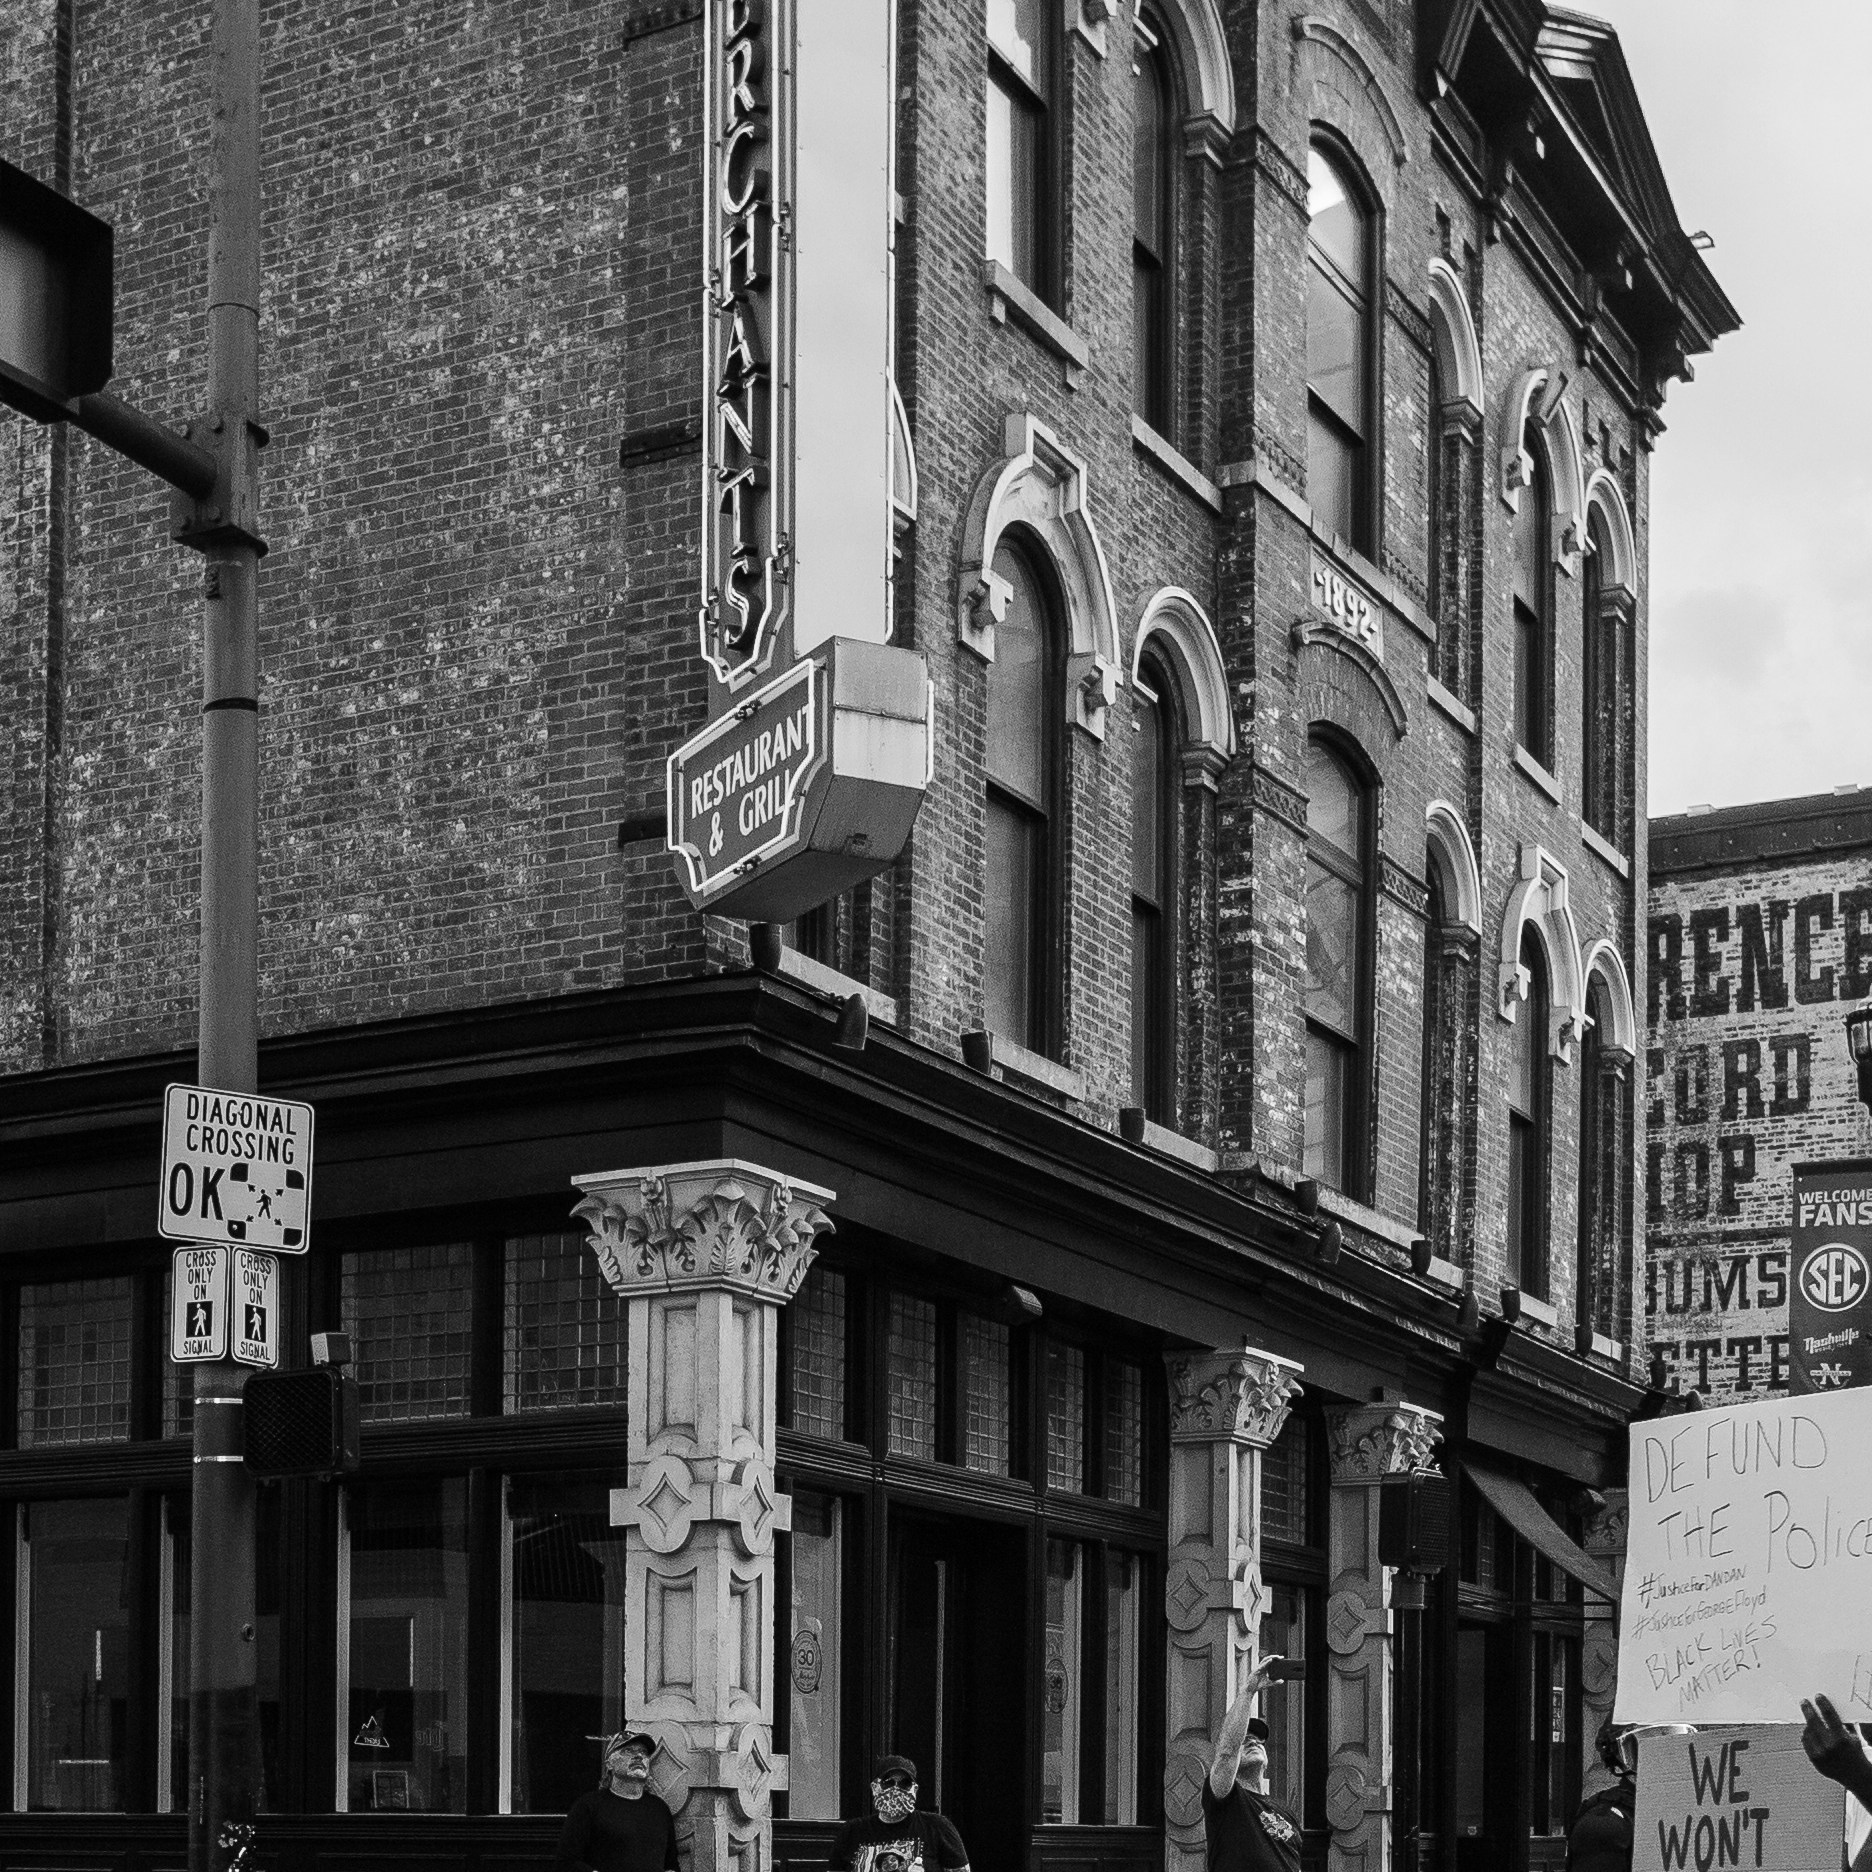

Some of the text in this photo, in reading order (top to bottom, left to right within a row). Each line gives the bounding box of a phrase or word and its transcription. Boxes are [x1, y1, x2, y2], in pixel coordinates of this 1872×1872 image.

[718, 0, 770, 652] RCHANTS
[1313, 567, 1378, 642] 1892
[691, 703, 813, 819] RESTAURANT
[709, 769, 796, 857] & GRILL
[186, 1093, 297, 1136] DIAGONAL
[186, 1124, 295, 1165] CROSSING
[168, 1161, 226, 1221] OK
[185, 1251, 217, 1268] CROSS
[188, 1268, 214, 1285] ONLY
[240, 1254, 272, 1274] CROSS
[243, 1271, 268, 1290] ONLY
[1807, 1250, 1862, 1305] SEC
[193, 1284, 207, 1300] ON
[249, 1287, 263, 1305] ON
[182, 1339, 214, 1356] SIGNAL
[239, 1341, 271, 1361] SIGNAL
[1644, 1416, 1827, 1504] DEFUND
[1657, 1503, 1733, 1561] THE
[797, 1648, 815, 1667] 30
[1645, 1614, 1777, 1691] BLACK LIVES
[1688, 1740, 1751, 1806] WE
